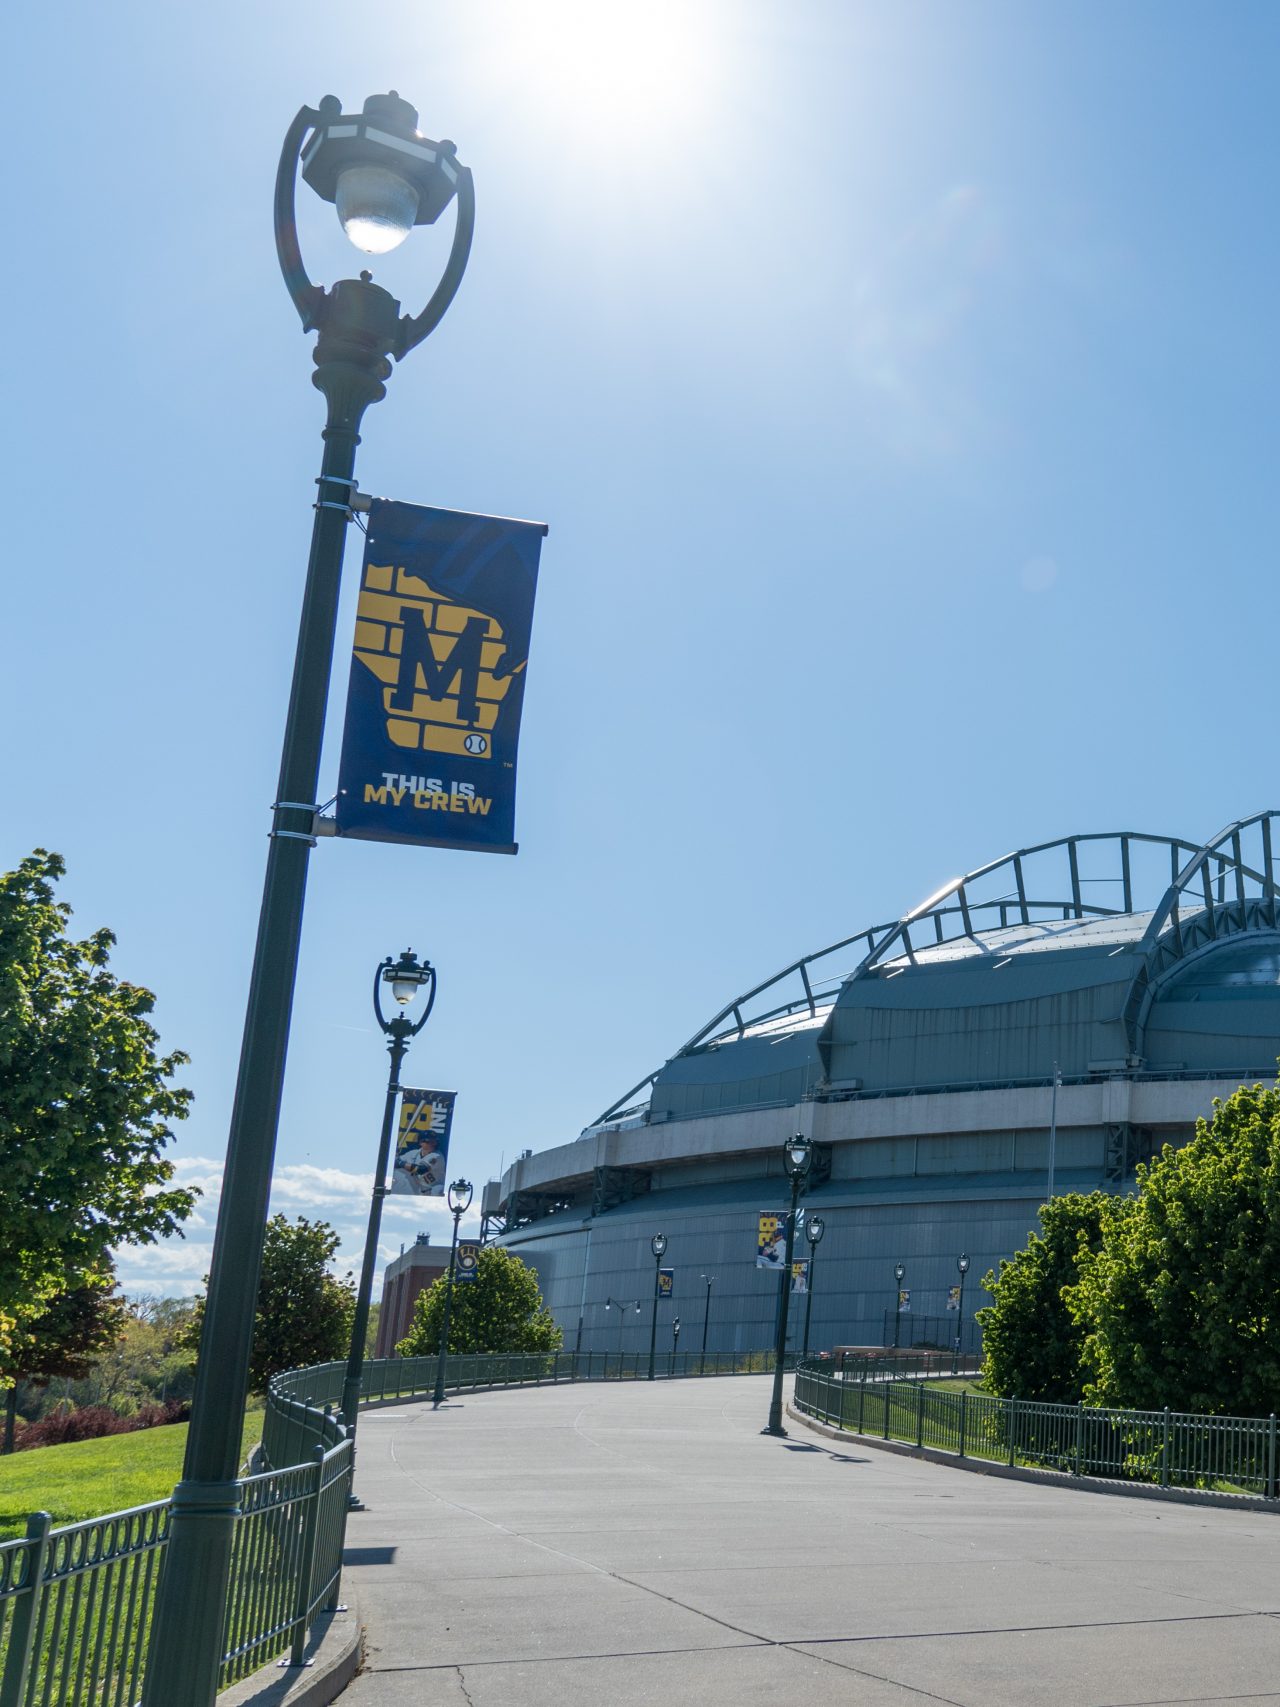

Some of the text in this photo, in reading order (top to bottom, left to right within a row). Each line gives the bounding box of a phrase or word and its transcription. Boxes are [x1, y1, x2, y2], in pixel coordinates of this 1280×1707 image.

[389, 606, 491, 724] M
[364, 784, 492, 816] MY CREW
[382, 772, 475, 800] THIS IS
[429, 1101, 448, 1134] INF
[758, 1217, 778, 1247] 38
